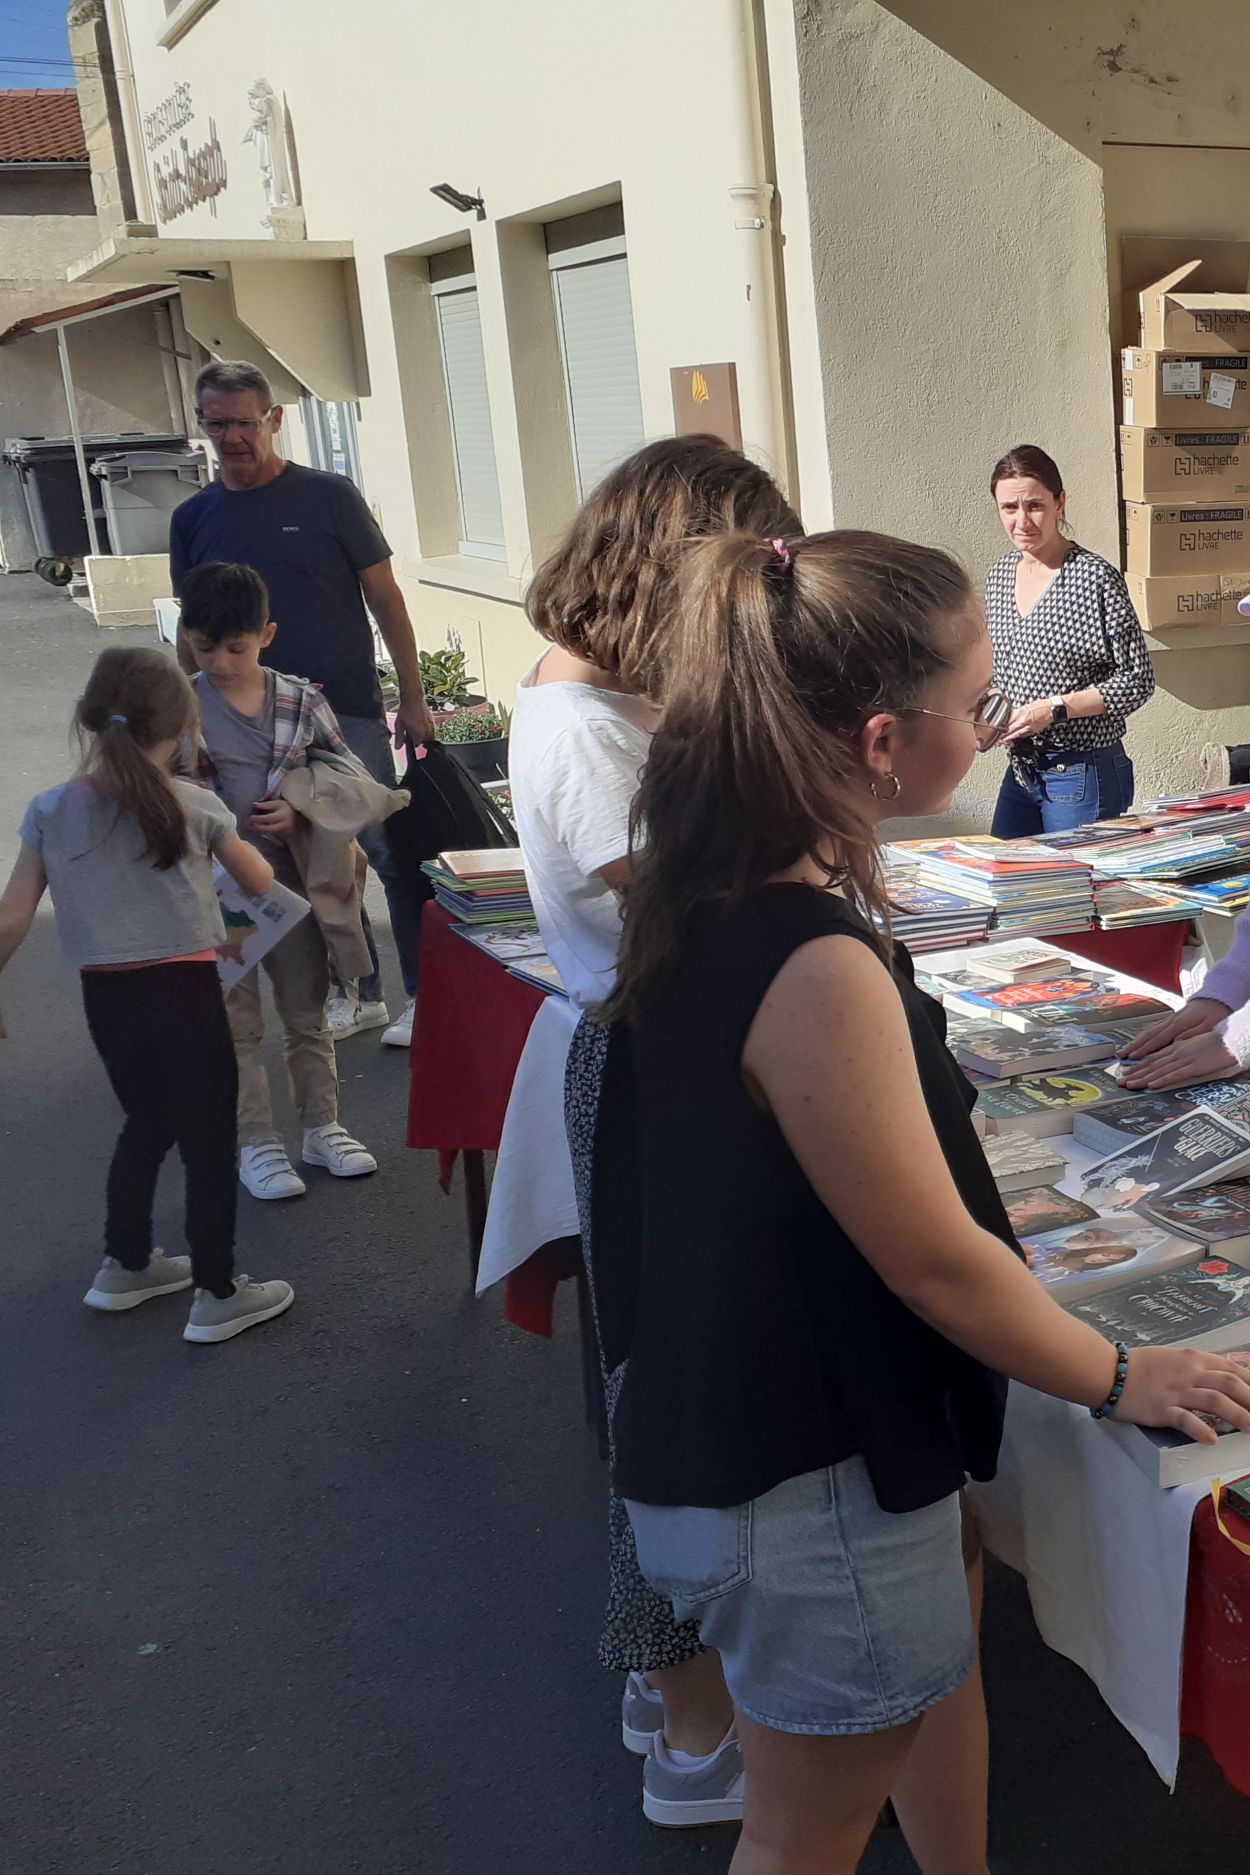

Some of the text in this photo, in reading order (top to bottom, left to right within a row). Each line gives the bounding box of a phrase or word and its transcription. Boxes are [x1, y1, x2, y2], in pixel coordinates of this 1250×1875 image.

[1215, 359, 1247, 368] FRAGILE
[1176, 434, 1200, 445] Livres
[1206, 434, 1239, 445] FRAGILE
[1193, 454, 1239, 466] hachette
[1193, 467, 1215, 475] LIVRE
[1182, 512, 1205, 521] Livres
[1210, 510, 1242, 520] FRAGILE
[1198, 530, 1243, 541] hachette
[1198, 542, 1219, 550] LIVRE
[1196, 590, 1242, 602] hachette
[1196, 603, 1218, 611] LIVRE
[1179, 1118, 1241, 1158] GUERRIERS
[1173, 1138, 1210, 1162] GLACE
